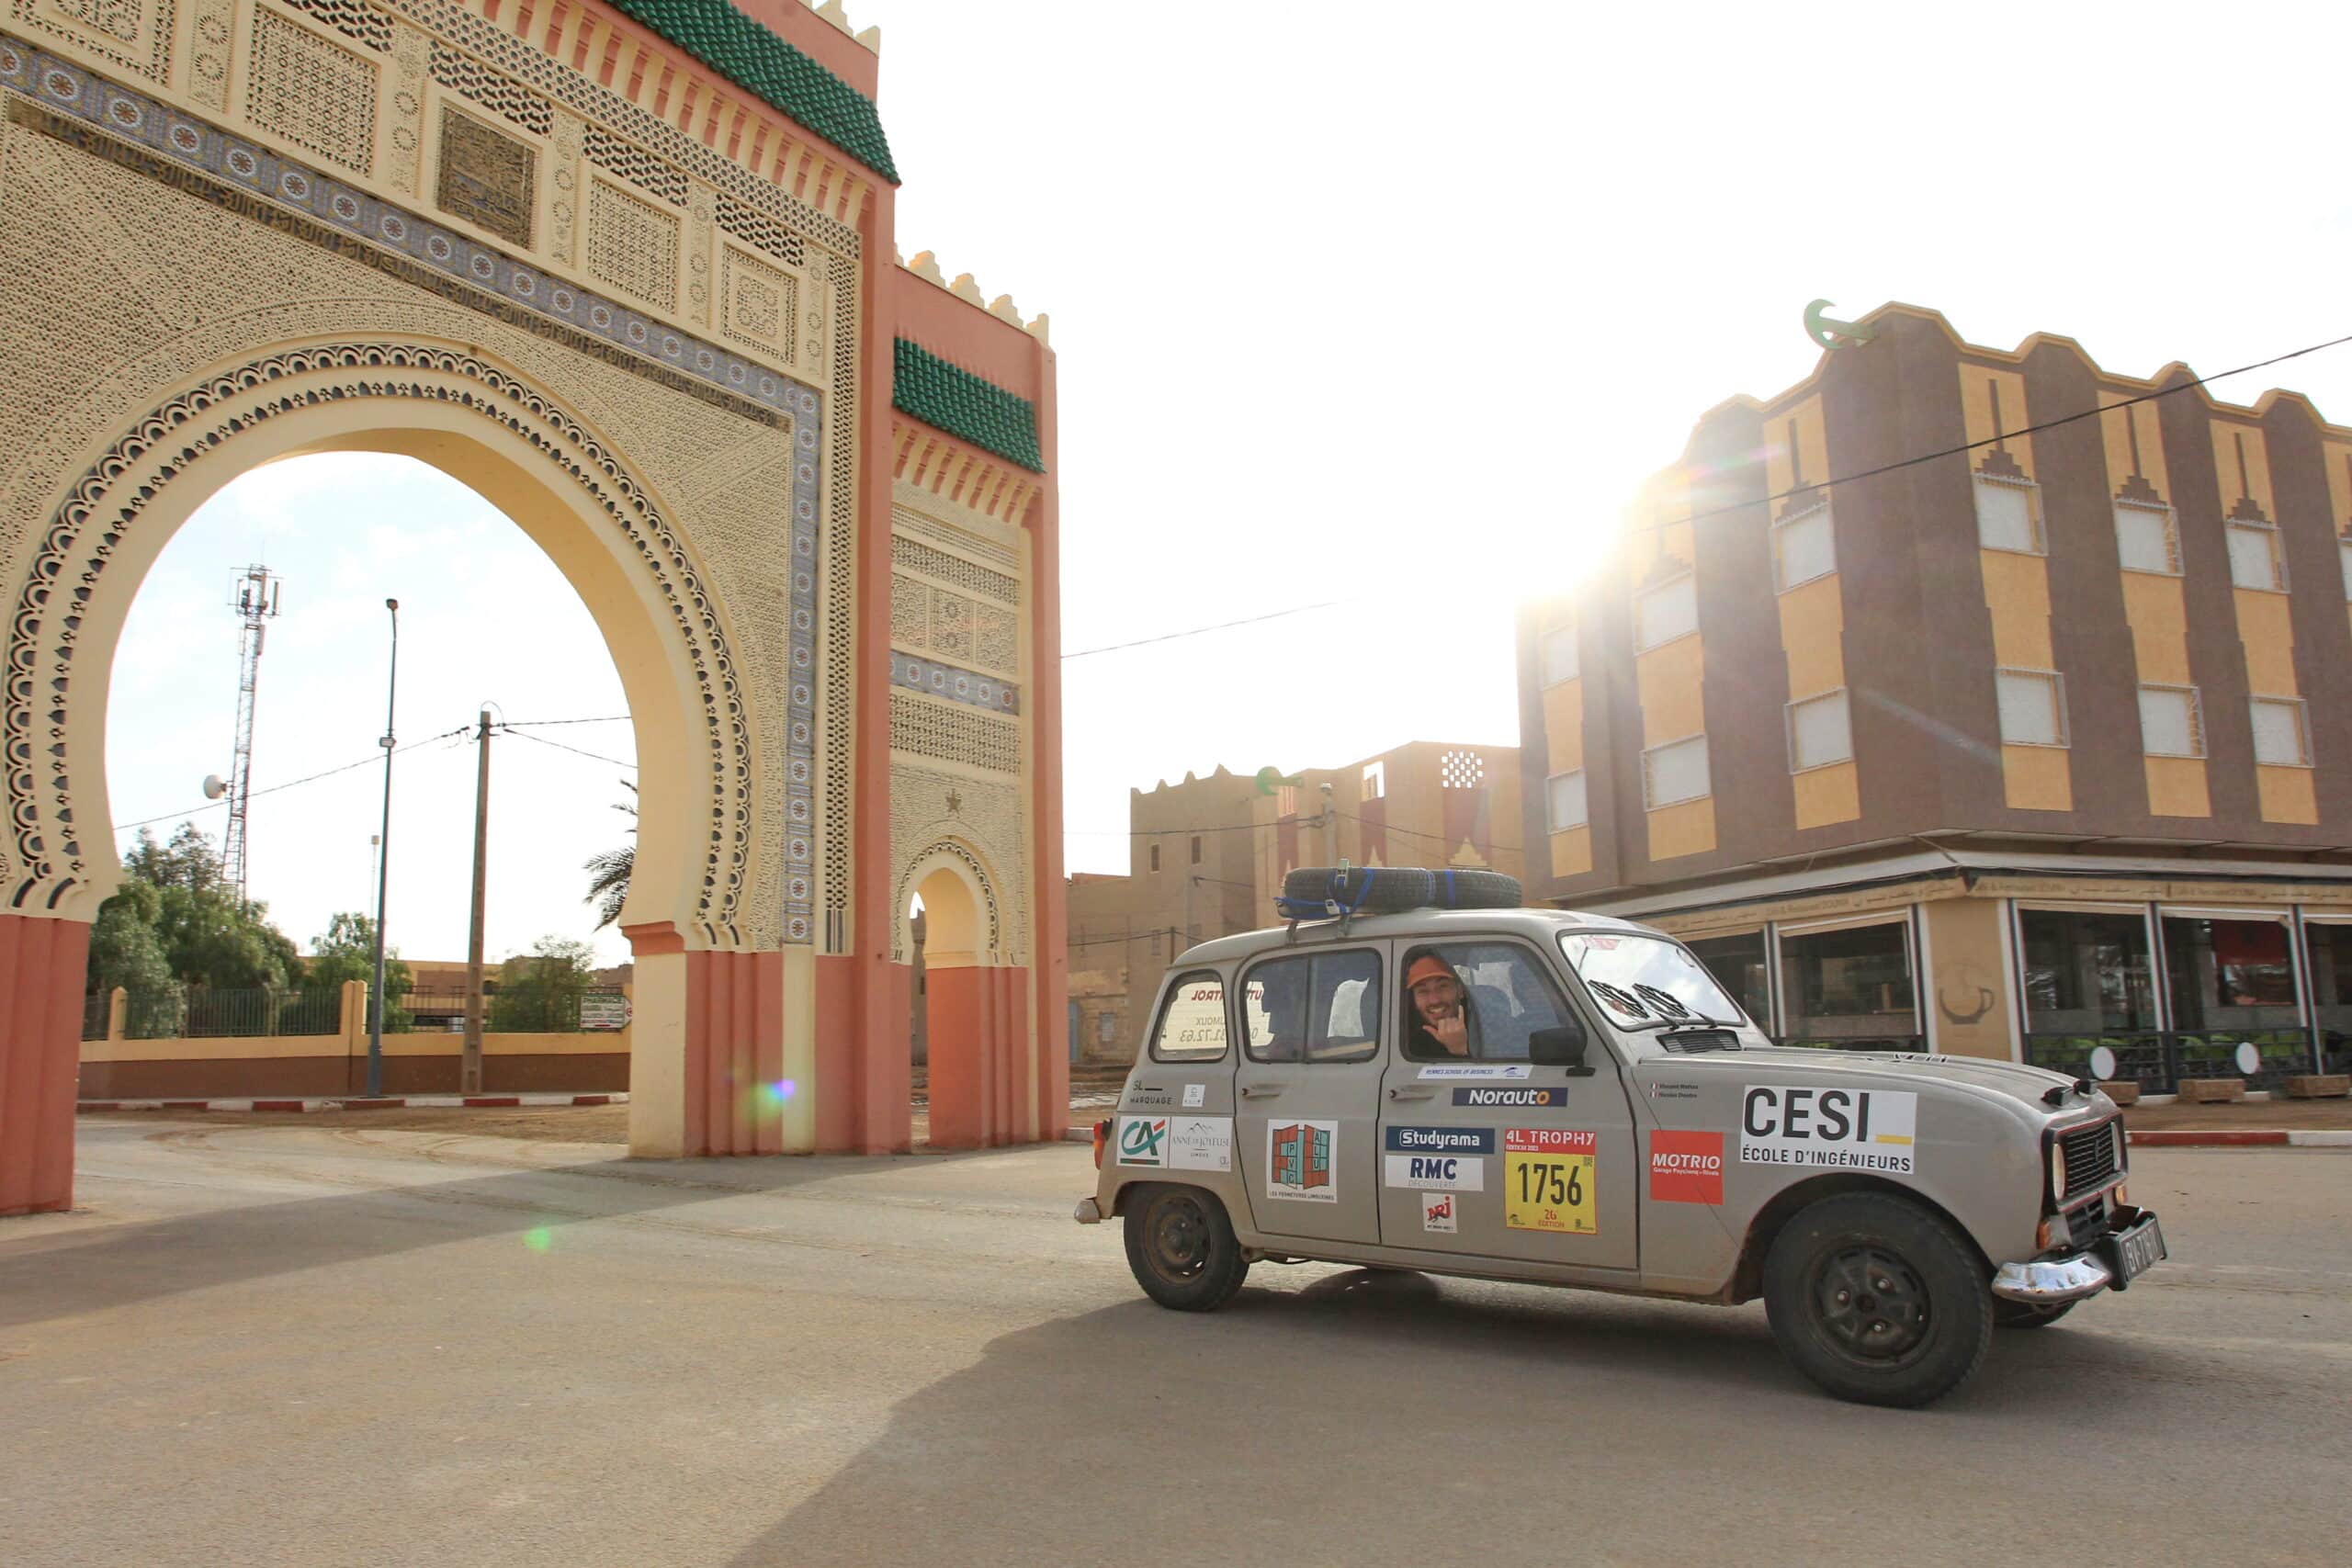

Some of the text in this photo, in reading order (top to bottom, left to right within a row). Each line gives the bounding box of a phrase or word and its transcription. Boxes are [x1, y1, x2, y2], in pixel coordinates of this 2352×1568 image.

[1130, 1097, 1172, 1105] MARQUAGE
[1469, 1089, 1551, 1105] Norauto
[1745, 1088, 1870, 1142] CESI
[1400, 1130, 1480, 1149] Studyrama
[1506, 1131, 1595, 1145] 4L TROPHY
[1652, 1153, 1721, 1169] MOTRIO
[1742, 1145, 1911, 1171] ÉCOLE D'INGÉNIEURS
[1410, 1157, 1457, 1179] RMC
[1517, 1163, 1582, 1206] 1756
[1544, 1209, 1557, 1220] 26
